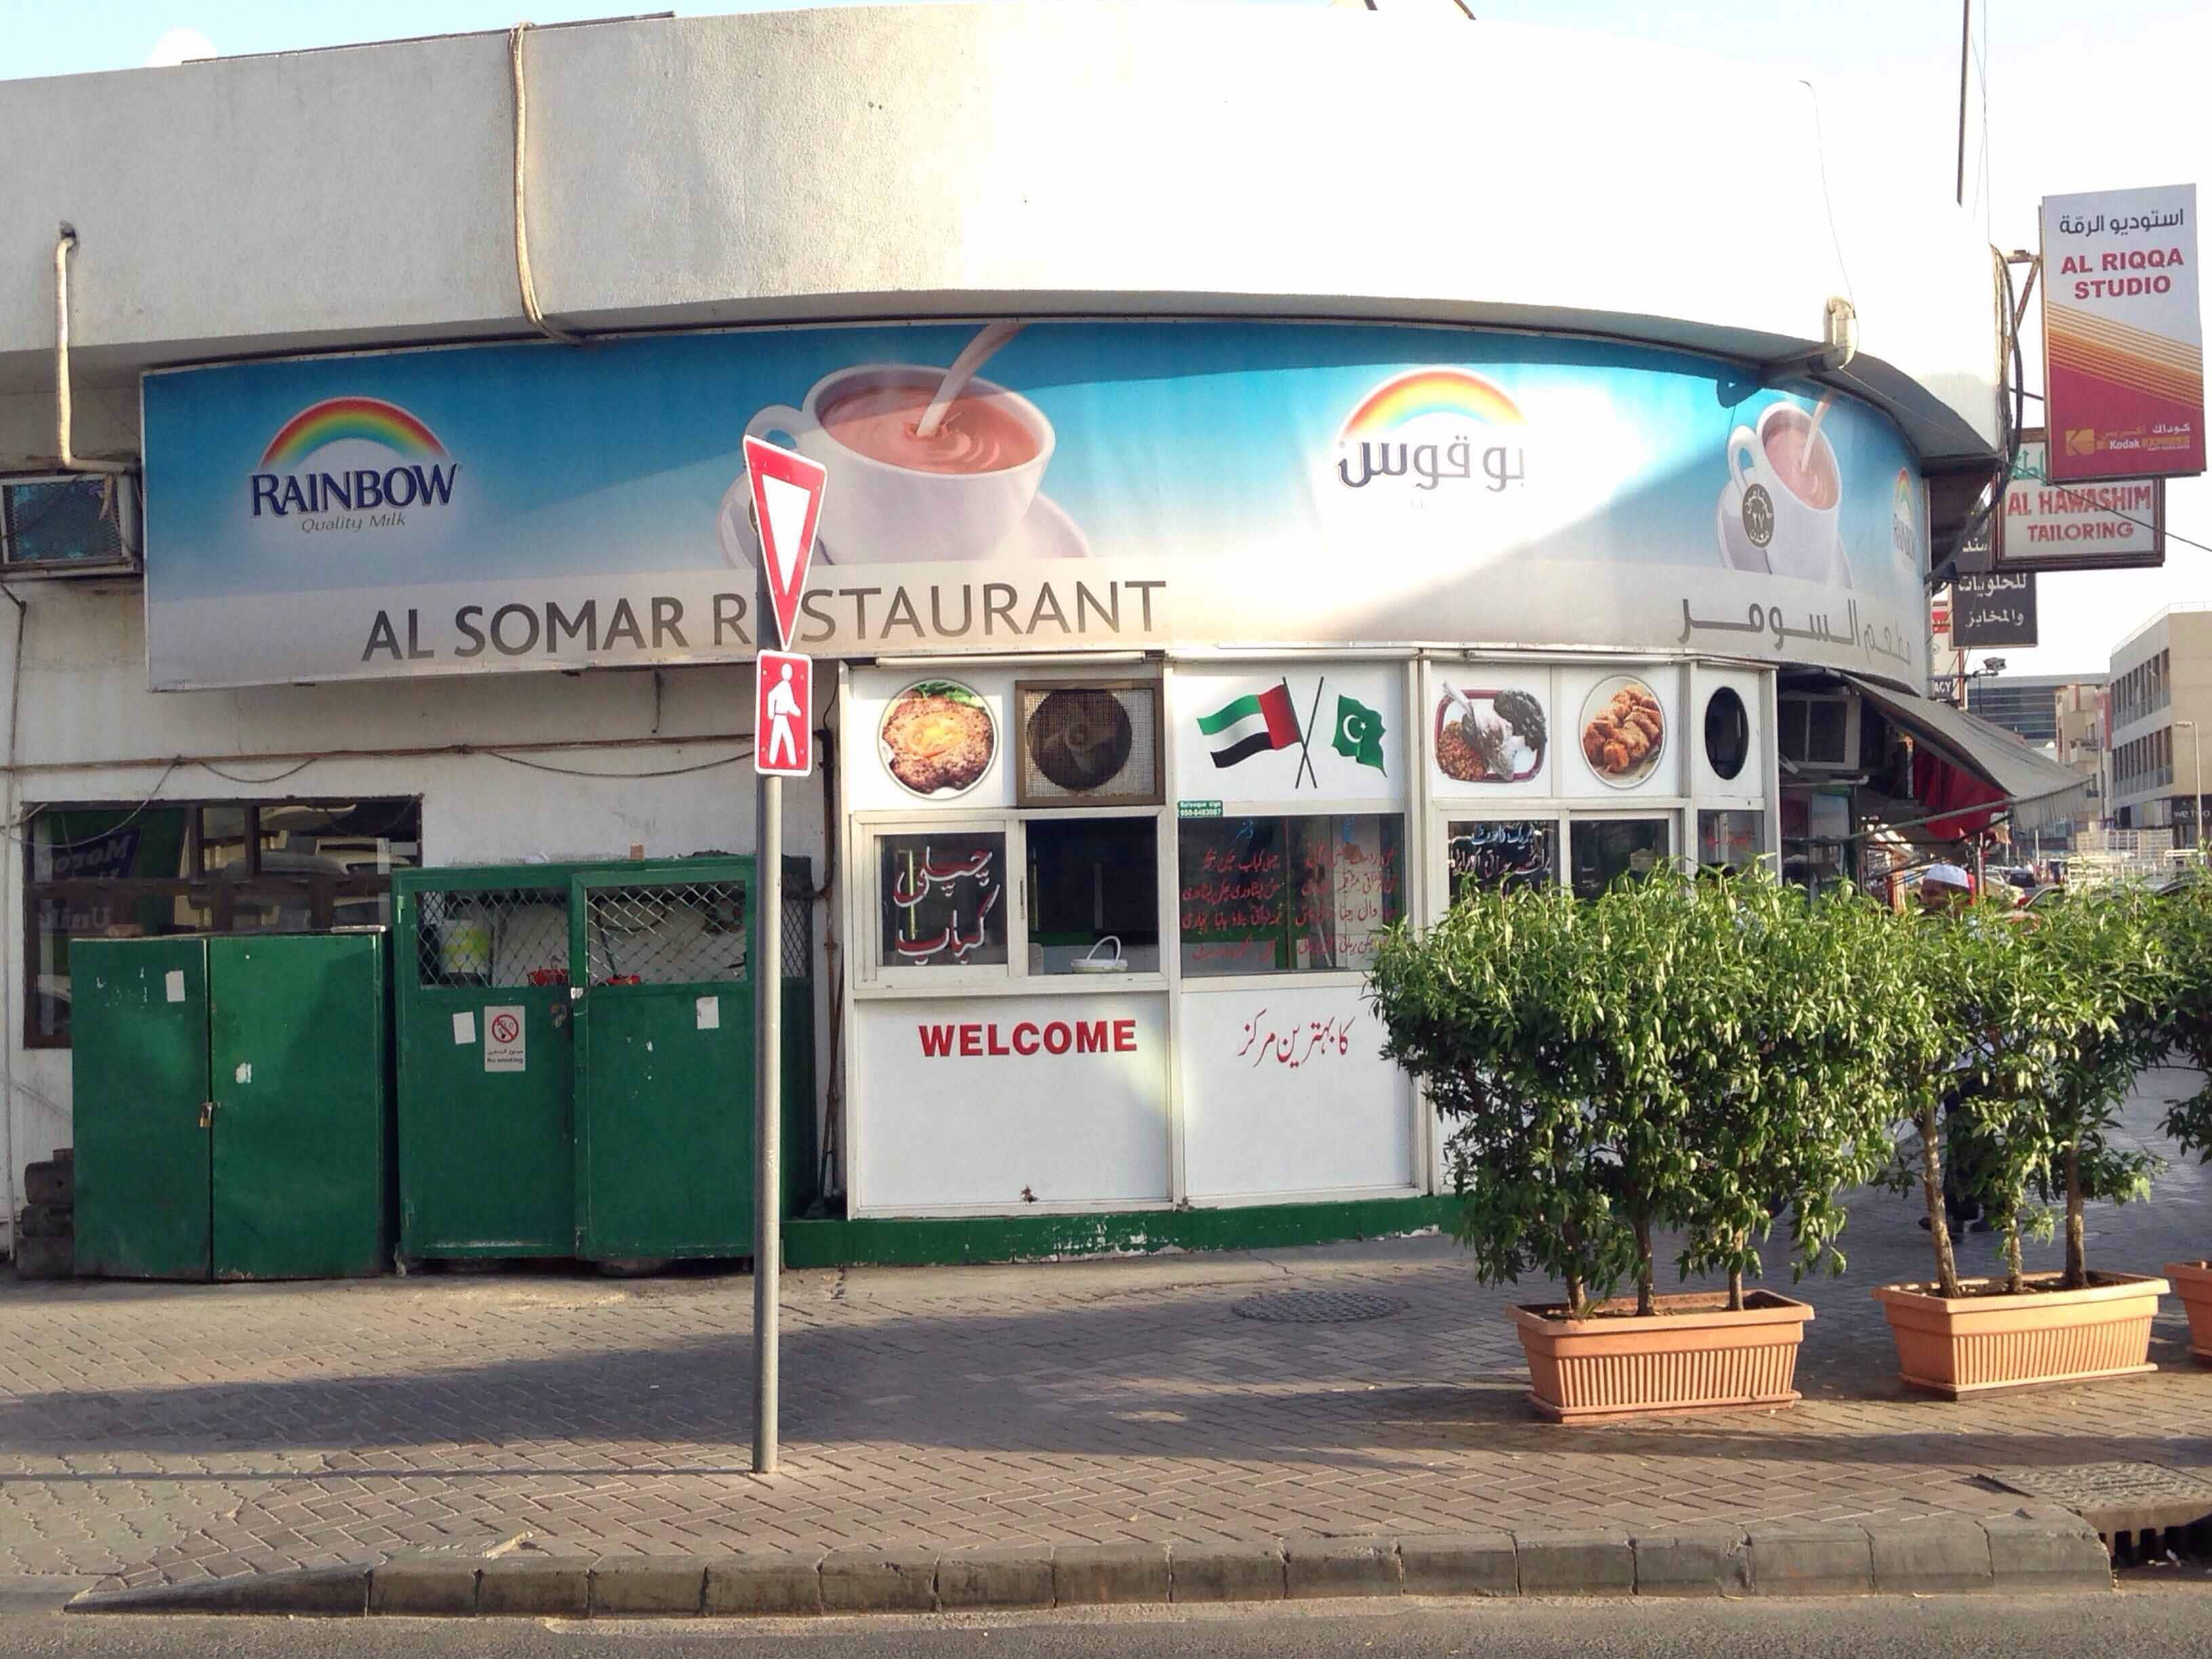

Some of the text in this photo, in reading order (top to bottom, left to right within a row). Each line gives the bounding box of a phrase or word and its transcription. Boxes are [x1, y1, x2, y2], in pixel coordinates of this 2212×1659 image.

[2110, 209, 2184, 235] استوديو
[2061, 248, 2184, 274] AL RIQQA
[2074, 275, 2171, 300] STUDIO
[2109, 438, 2140, 450] Kodak
[250, 462, 459, 518] RAINBOW
[2007, 480, 2151, 516] AL HAWASHIM
[301, 512, 406, 533] Quality Milk
[2027, 522, 2134, 543] TAILORING
[362, 581, 1167, 662] AL SOMAR RSTAURANT
[1677, 599, 1861, 651] السومر
[918, 1019, 1138, 1057] WELCOME
